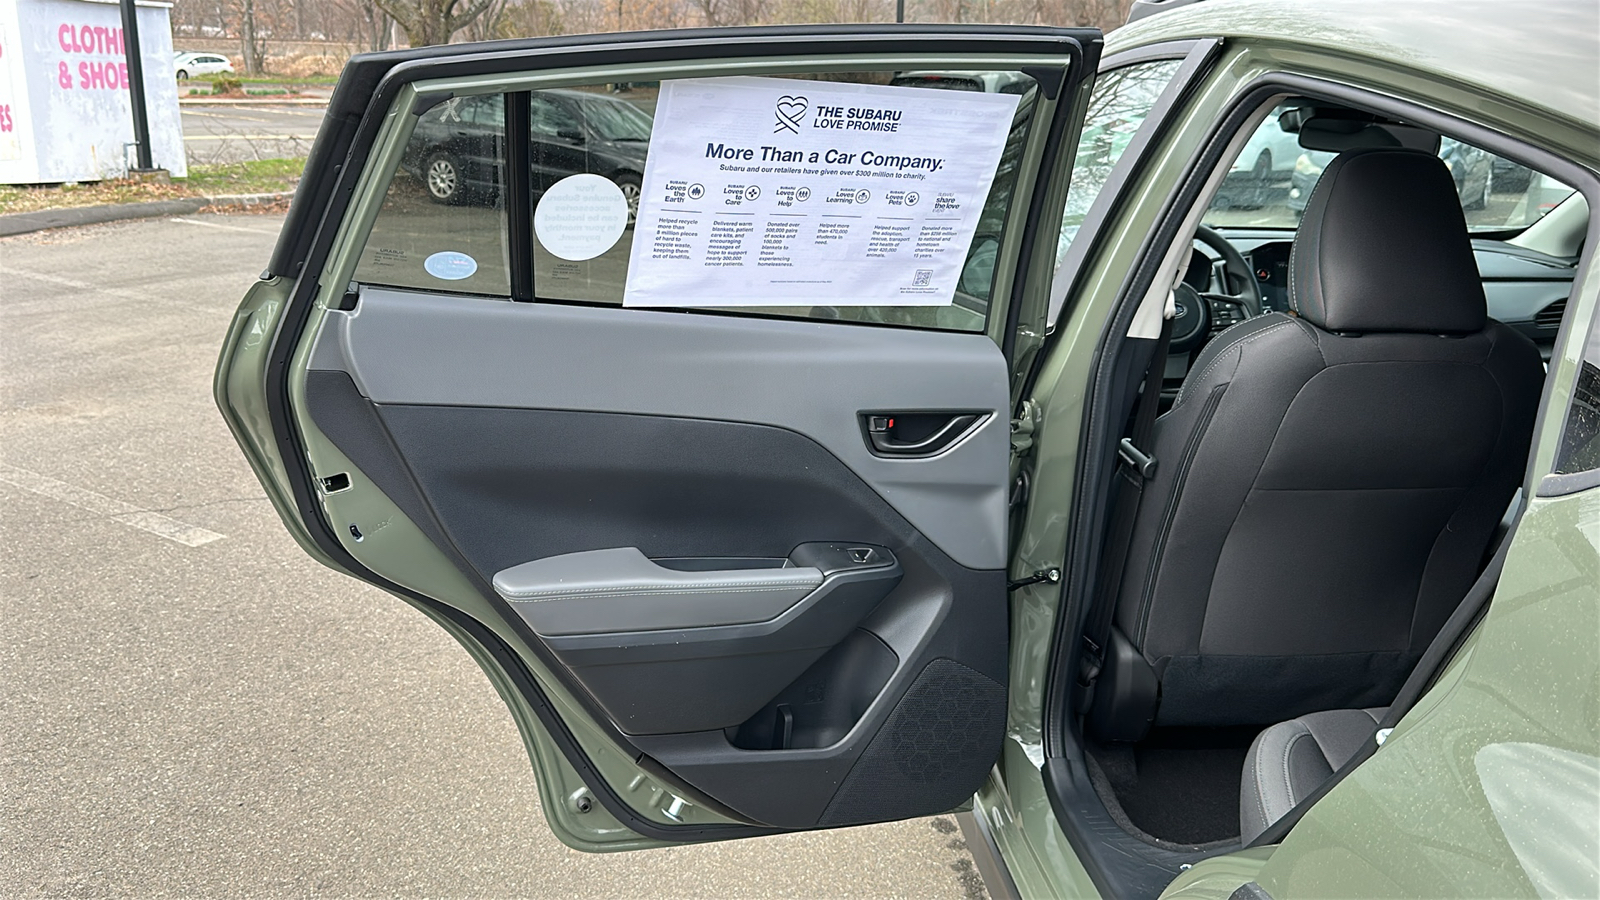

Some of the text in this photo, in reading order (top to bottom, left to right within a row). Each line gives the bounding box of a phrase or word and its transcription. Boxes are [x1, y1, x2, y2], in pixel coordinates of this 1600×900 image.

[59, 61, 72, 89] &
[816, 106, 902, 121] THE SUBARU
[813, 119, 843, 129] LOVE
[705, 143, 754, 161] More
[760, 147, 803, 163] Than
[808, 152, 819, 163] a
[824, 149, 857, 165] Car
[719, 164, 745, 172] Subaru
[820, 169, 838, 177] given
[903, 172, 926, 180] charity.
